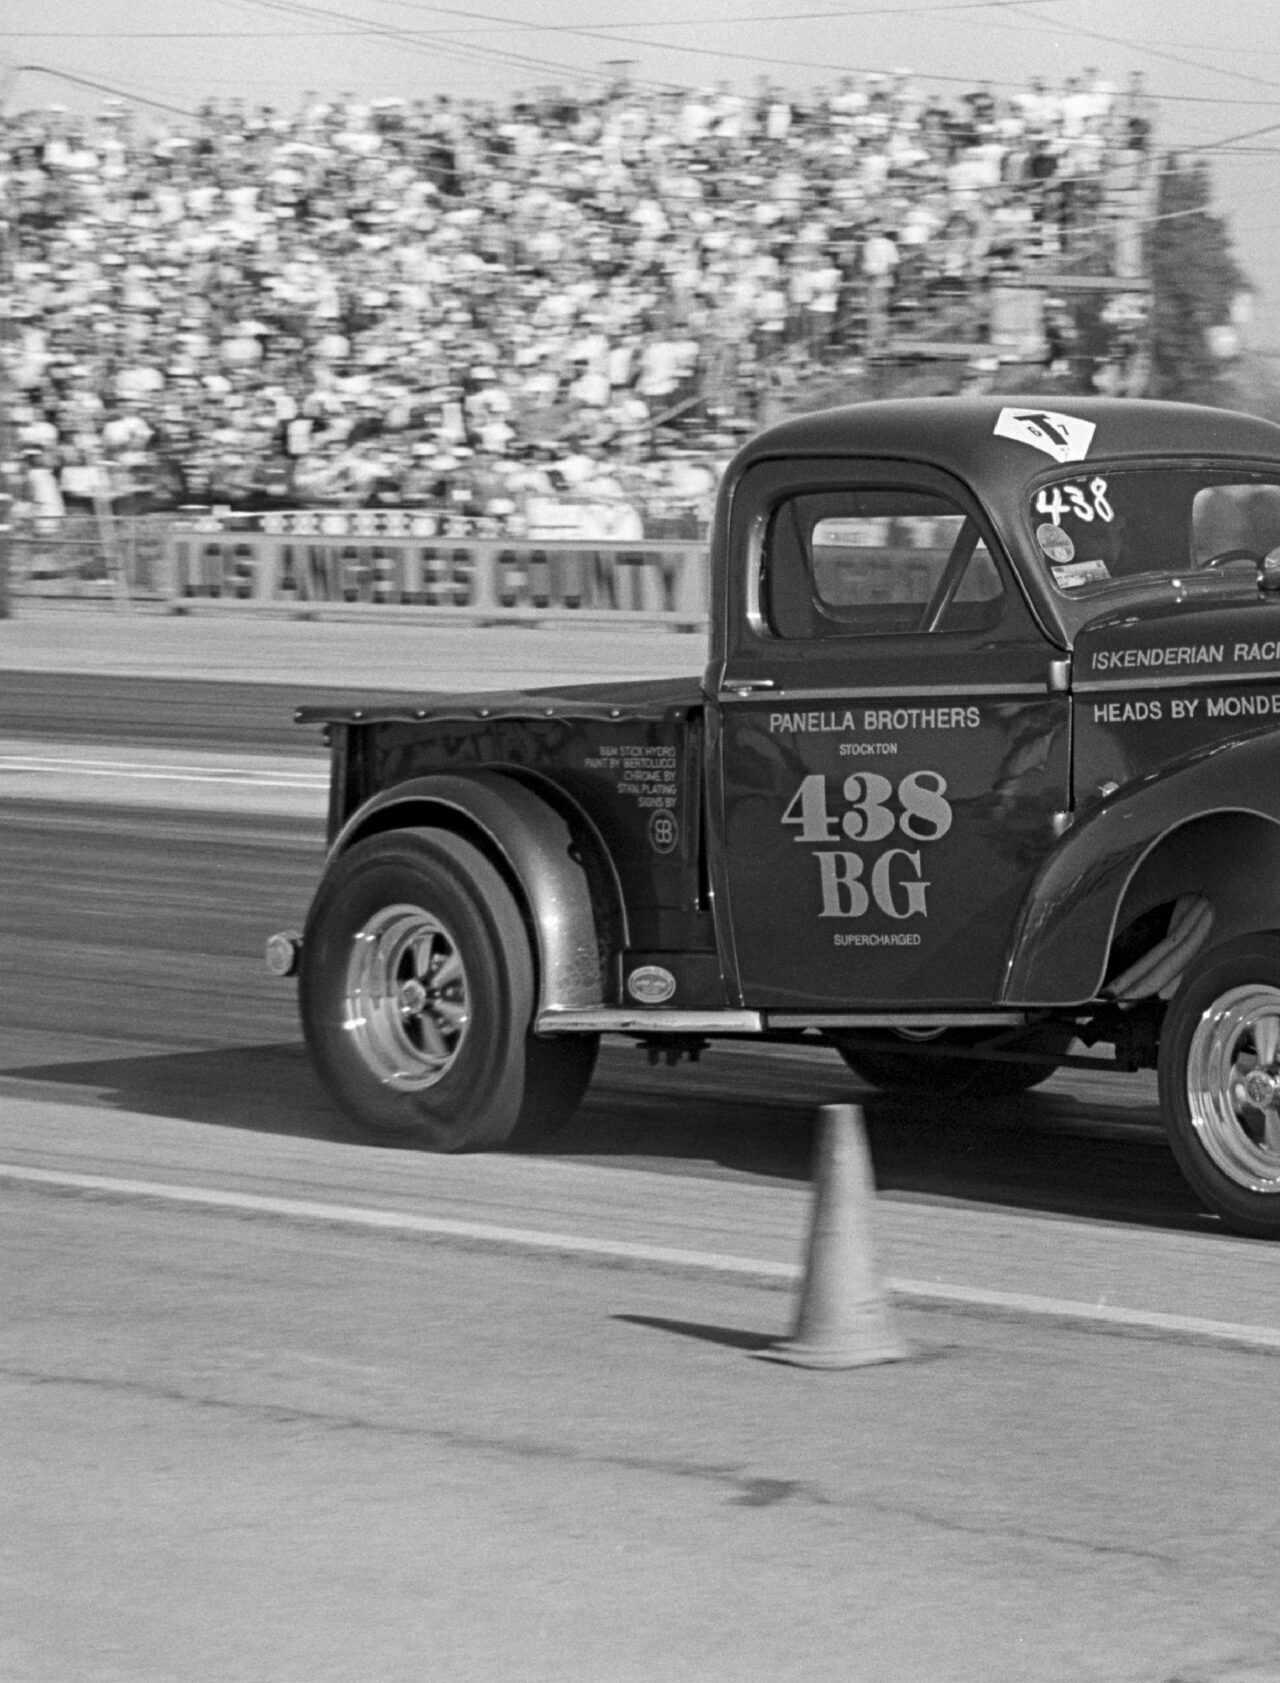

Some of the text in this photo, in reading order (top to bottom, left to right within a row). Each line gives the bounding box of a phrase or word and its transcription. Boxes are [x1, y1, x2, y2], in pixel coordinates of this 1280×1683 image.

[1035, 476, 1115, 527] 438
[175, 541, 686, 612] LOS ANGELES COUNTY
[1091, 644, 1225, 670] ISKENDERIAN
[769, 706, 981, 733] PANELLA BROTHERS
[1093, 701, 1163, 723] HEADS
[1170, 699, 1199, 719] BY
[838, 742, 899, 756] STOCKTON
[663, 769, 677, 782] BY
[665, 796, 678, 808] BY
[780, 769, 953, 843] 438
[811, 847, 932, 919] BG
[833, 933, 922, 946] SUPERCHARGED
